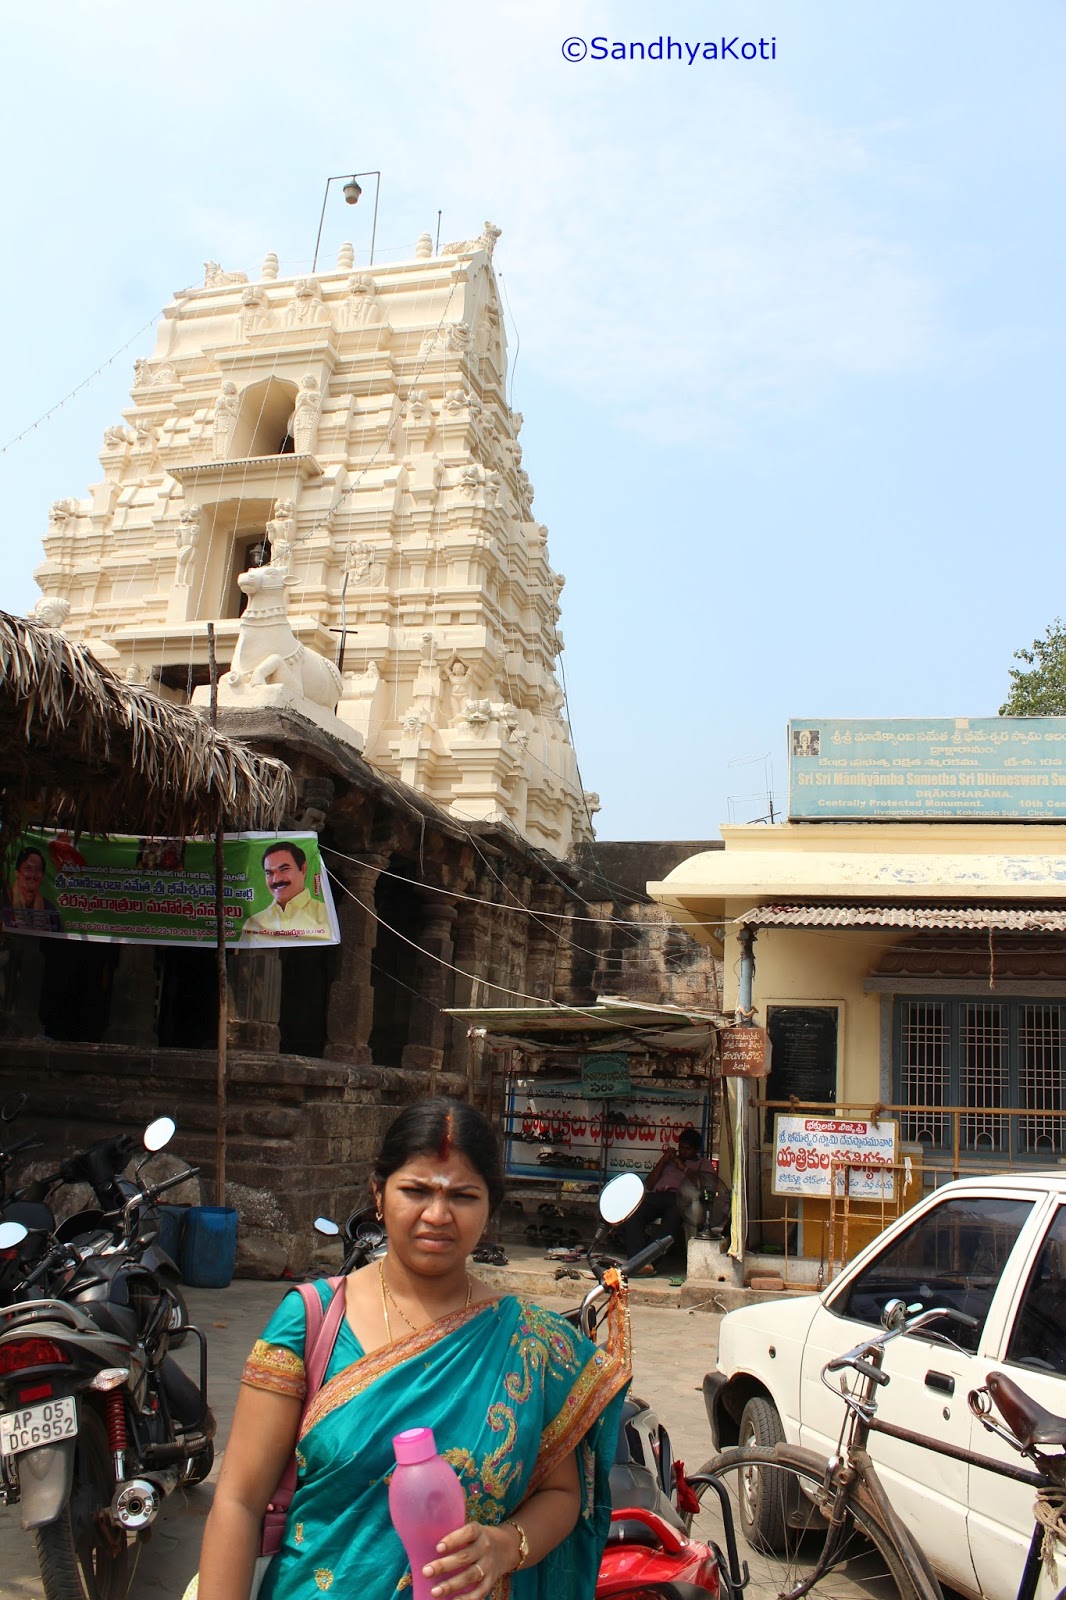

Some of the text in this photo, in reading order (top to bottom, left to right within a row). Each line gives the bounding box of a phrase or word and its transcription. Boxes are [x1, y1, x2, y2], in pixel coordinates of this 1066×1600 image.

[798, 772, 813, 785] Sri
[815, 772, 831, 785] Sri
[958, 772, 975, 786] Sri
[977, 772, 1049, 786] Bhimeswara
[818, 799, 867, 808] Centrally
[869, 799, 922, 807] Protected
[925, 799, 984, 807] Monument.
[1019, 799, 1043, 807] 10th
[55, 873, 66, 889] శ్రీ
[153, 880, 165, 895] శ్రీ
[13, 1402, 64, 1431] AP 05
[10, 1417, 74, 1450] DC6952
